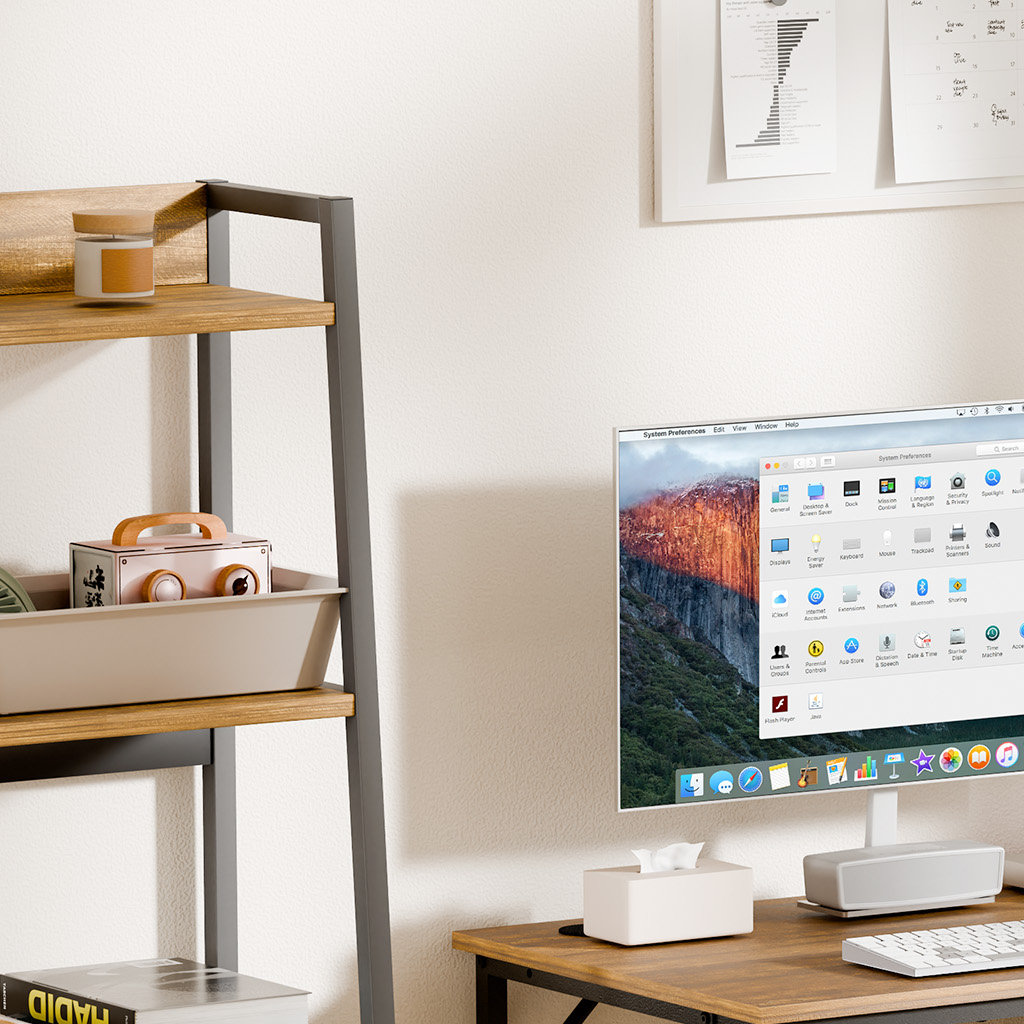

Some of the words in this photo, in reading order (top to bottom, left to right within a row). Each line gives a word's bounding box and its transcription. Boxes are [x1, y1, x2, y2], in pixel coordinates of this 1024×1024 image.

[643, 430, 668, 439] System
[668, 428, 706, 437] Preferences
[784, 421, 800, 429] Help
[878, 454, 899, 462] System
[900, 452, 932, 460] Preferences
[780, 716, 796, 724] Player
